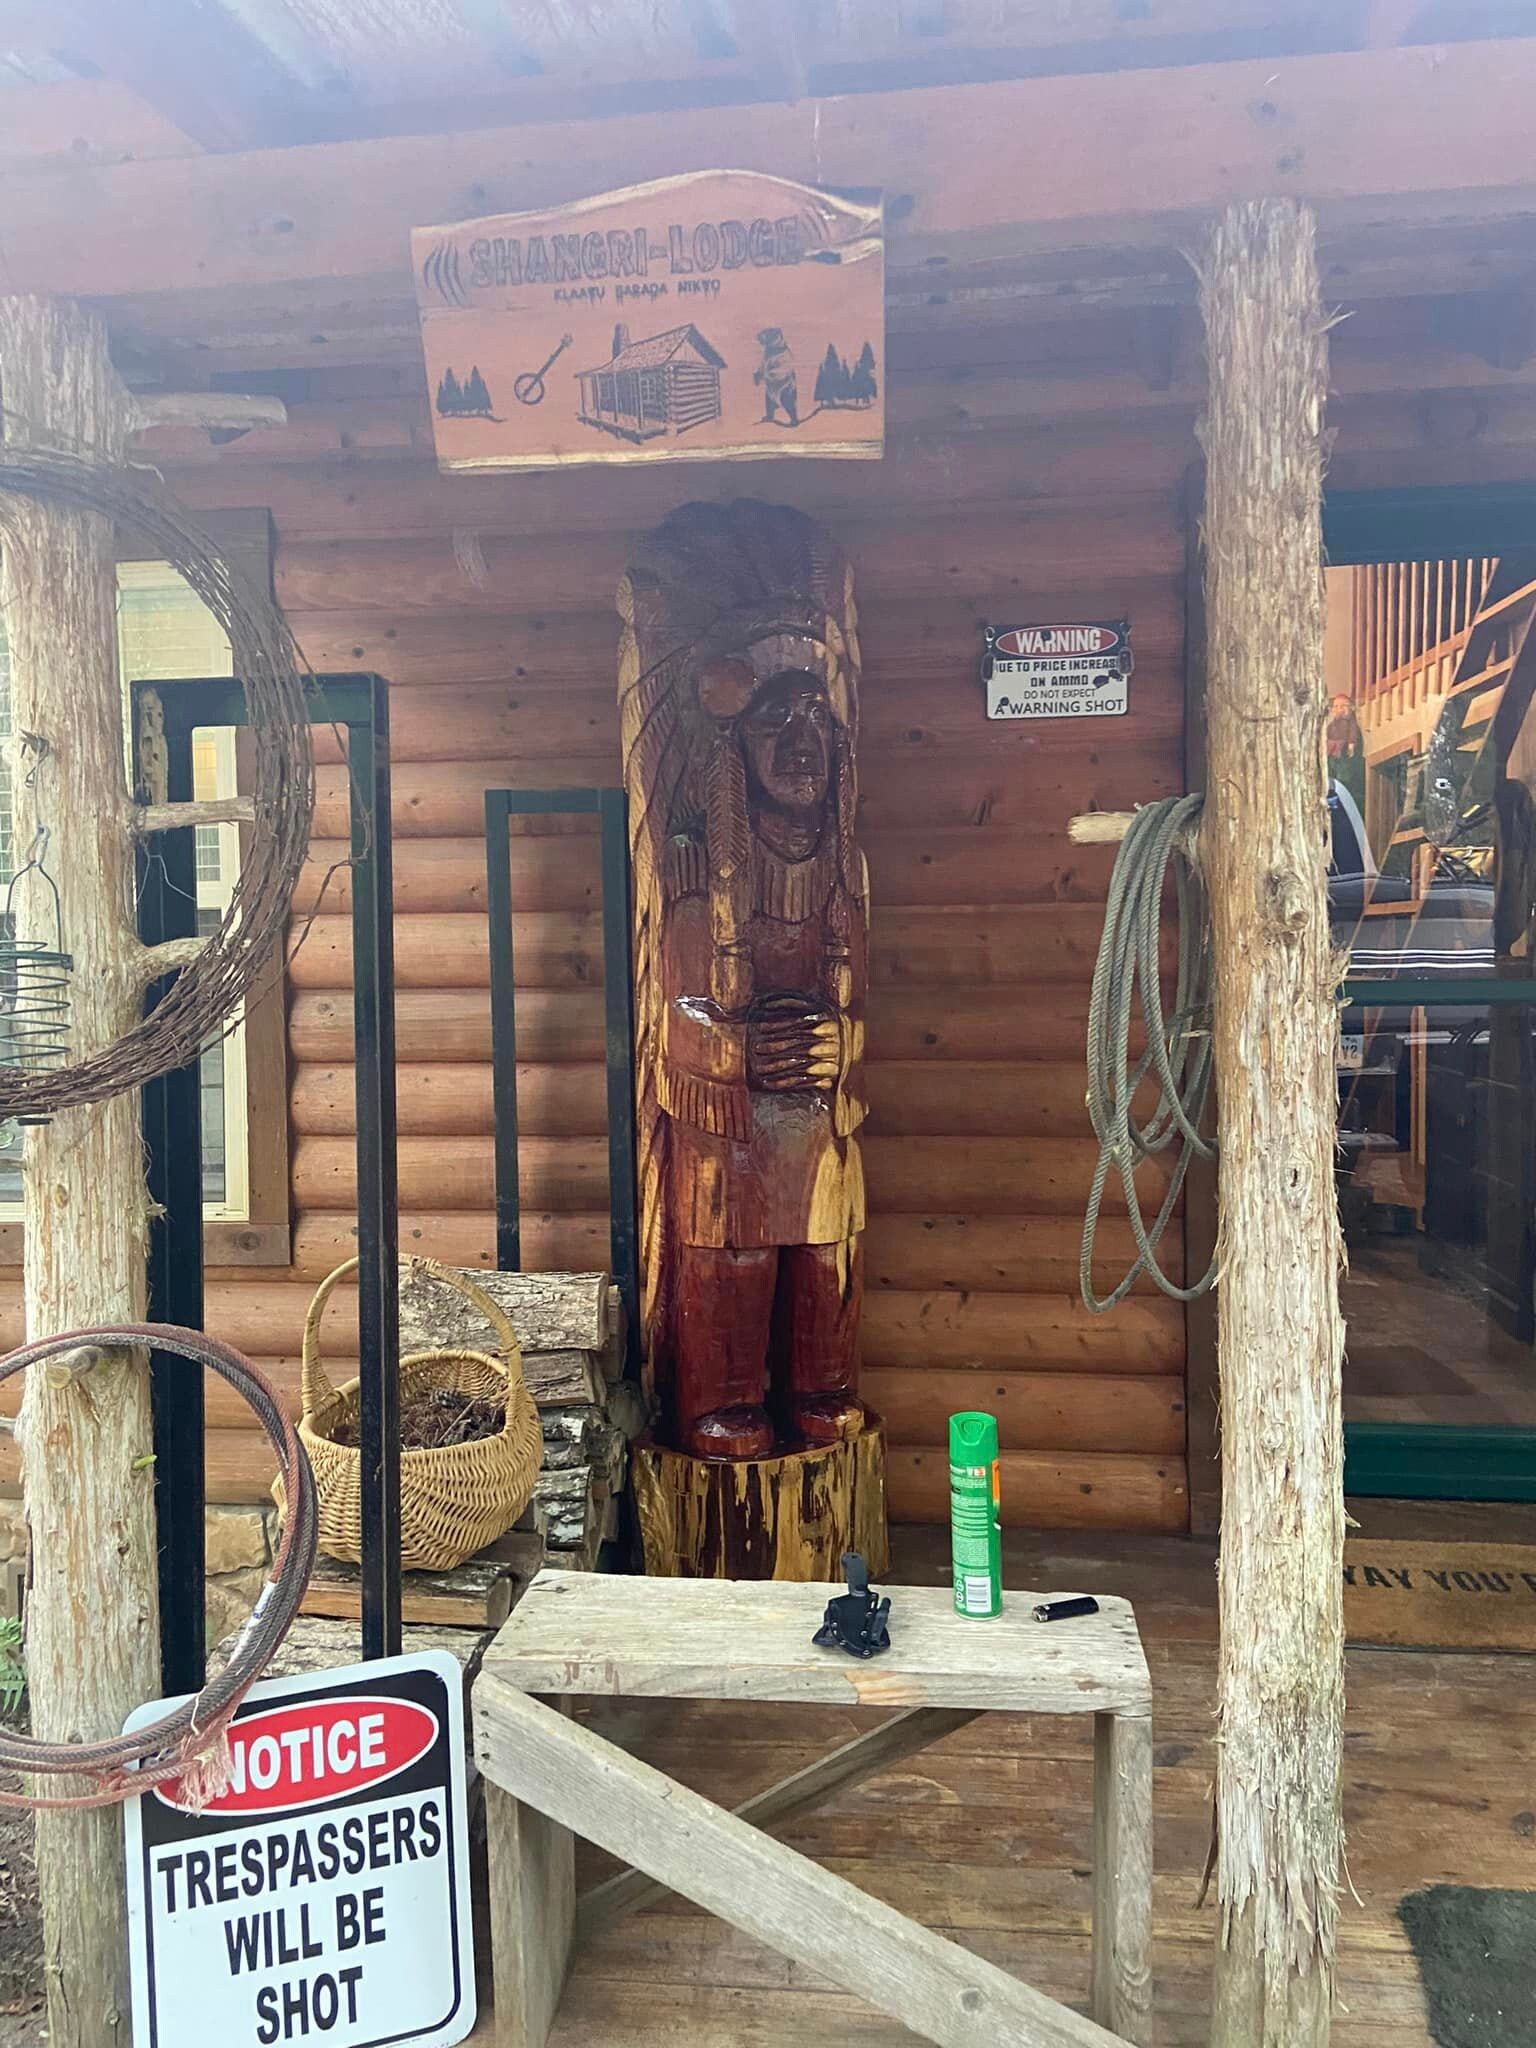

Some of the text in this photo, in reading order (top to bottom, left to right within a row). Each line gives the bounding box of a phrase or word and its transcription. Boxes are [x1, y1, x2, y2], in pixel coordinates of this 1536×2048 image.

[470, 214, 802, 290] SHANGRI-LODGE
[615, 282, 668, 303] BARADA
[1015, 628, 1101, 654] WARNING
[995, 658, 1119, 672] UE TO PRICE INCREAS
[1023, 687, 1096, 700] DO NOT EXPECT
[1030, 674, 1089, 687] ON AMMO
[994, 698, 1125, 715] A WARNING SHOT
[229, 1712, 387, 1795] NOTICE
[156, 1799, 442, 1914] TRESPASSERS
[223, 1886, 387, 1976] WILL BE
[256, 1965, 364, 2046] SHOT
